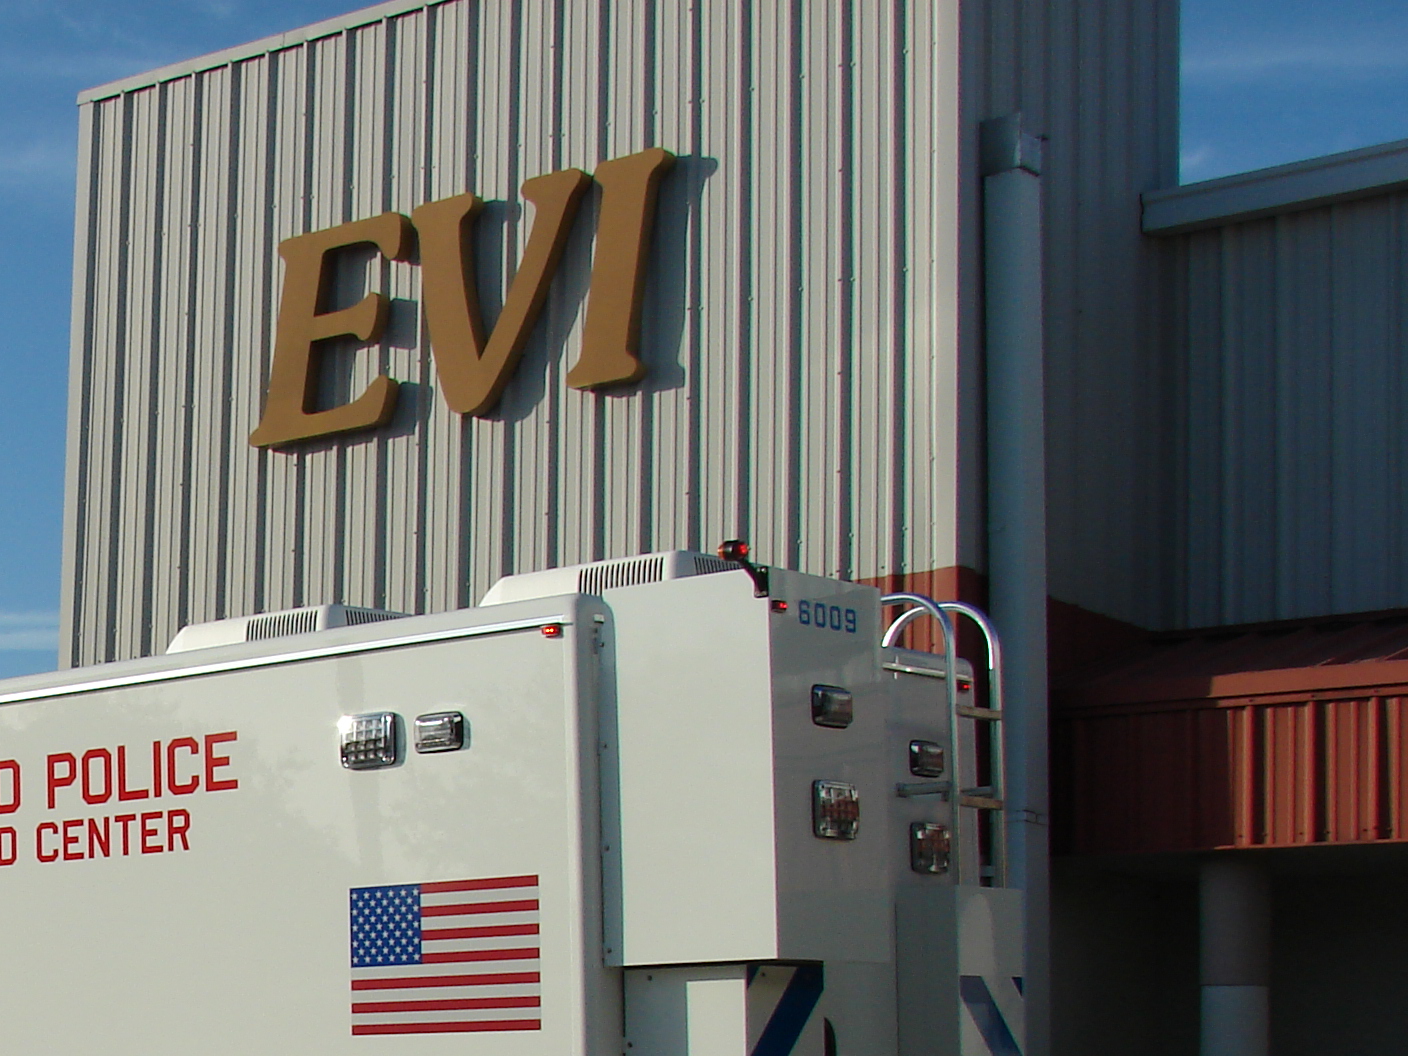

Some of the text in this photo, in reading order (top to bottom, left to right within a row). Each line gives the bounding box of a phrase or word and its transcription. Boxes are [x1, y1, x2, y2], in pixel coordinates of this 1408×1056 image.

[249, 147, 676, 449] EVI
[798, 599, 857, 634] 6009
[46, 730, 239, 810] POLICE
[35, 808, 191, 864] CENTER
